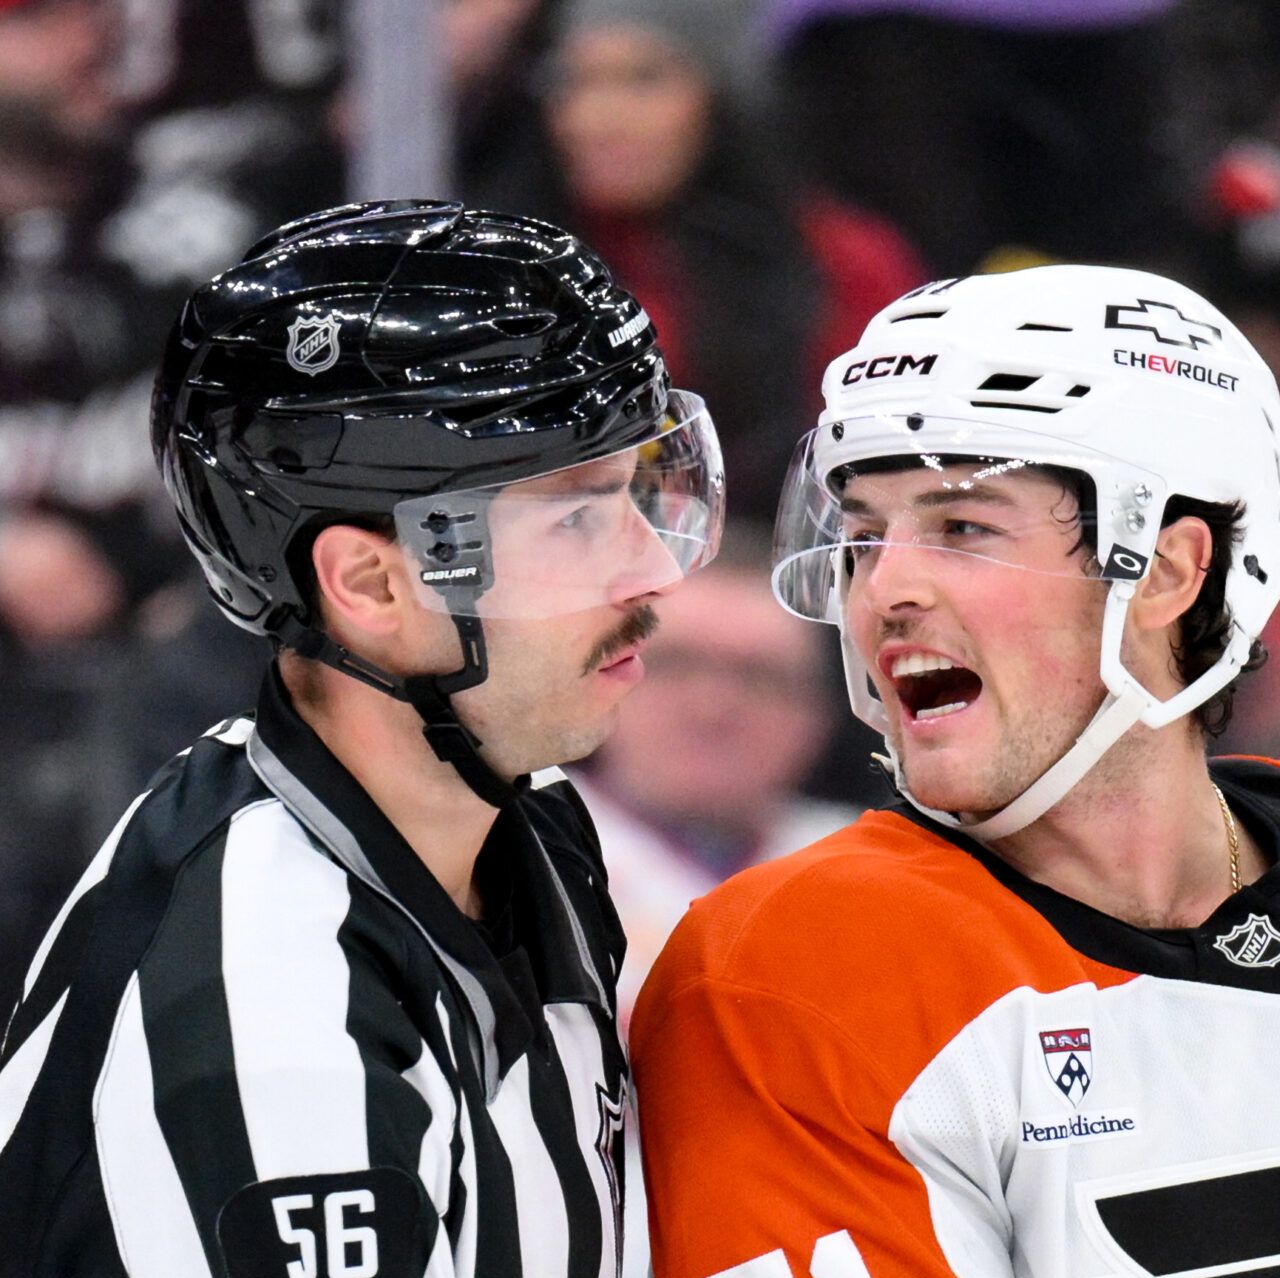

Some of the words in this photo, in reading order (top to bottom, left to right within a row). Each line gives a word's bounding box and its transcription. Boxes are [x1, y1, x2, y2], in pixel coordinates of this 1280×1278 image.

[300, 331, 328, 360] NHL
[842, 354, 939, 386] CCM
[1113, 349, 1240, 392] CHEVROLET
[422, 566, 478, 581] BAUER
[1241, 932, 1267, 962] NHL
